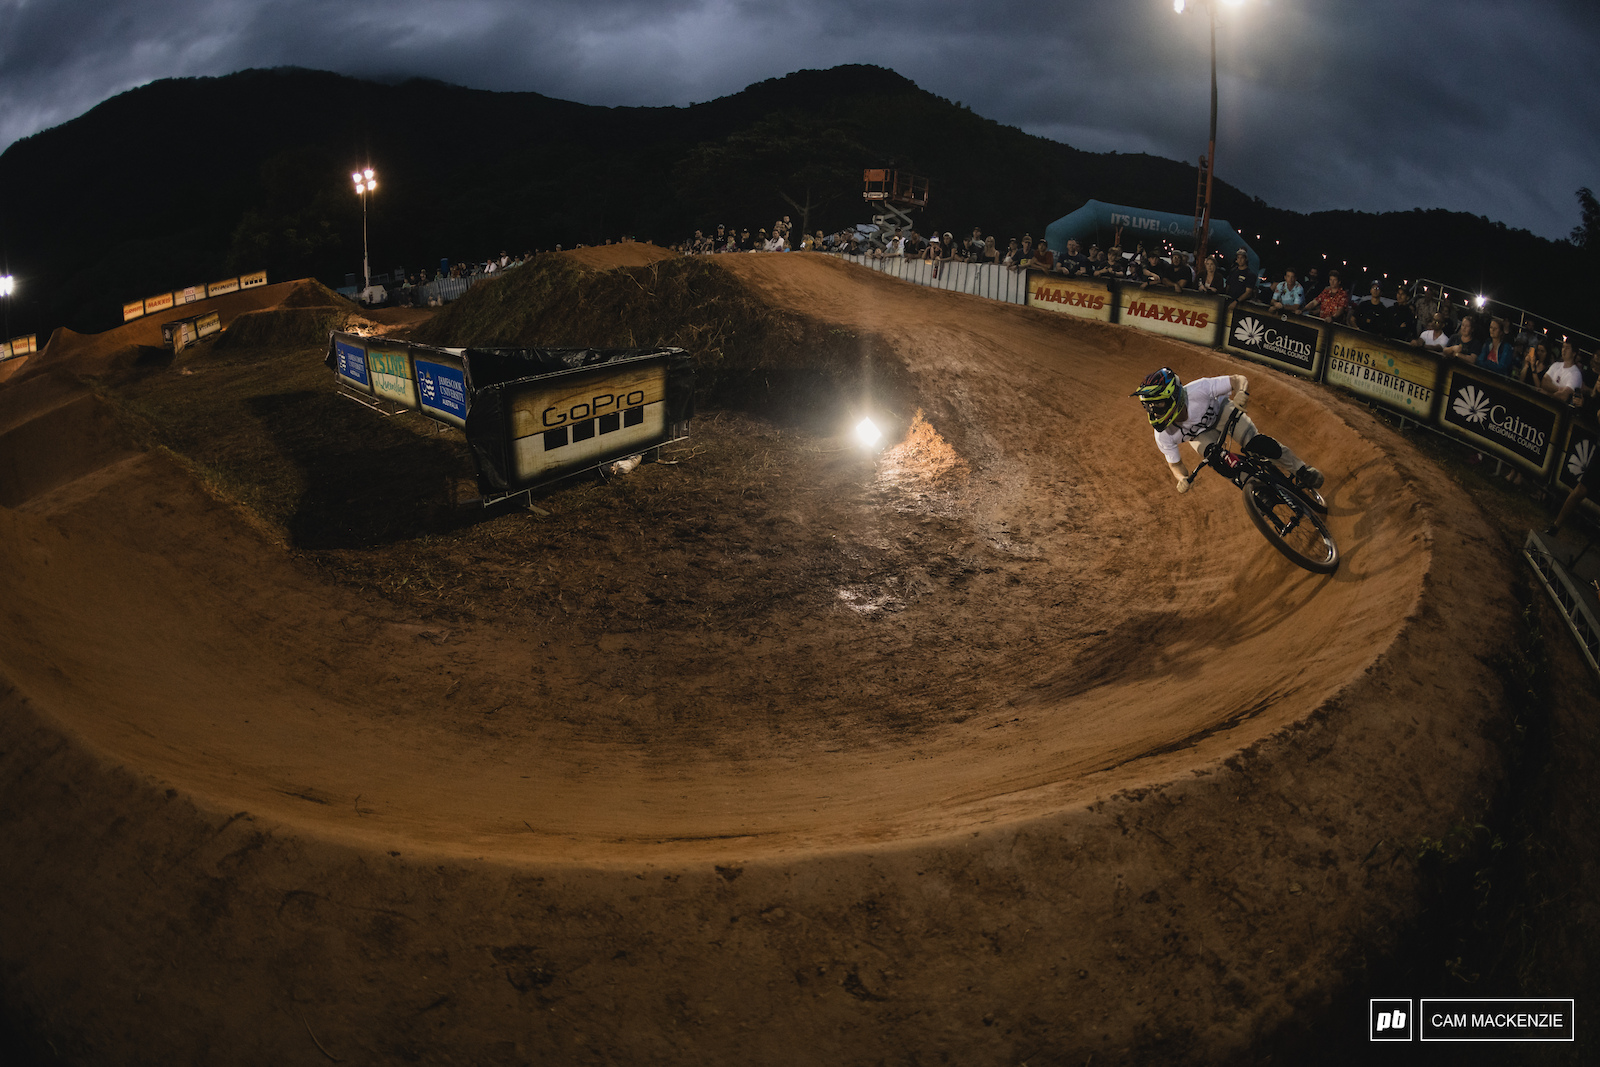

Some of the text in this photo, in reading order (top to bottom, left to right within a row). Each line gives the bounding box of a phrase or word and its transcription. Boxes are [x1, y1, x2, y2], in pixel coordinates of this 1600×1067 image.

[1111, 212, 1131, 227] IT'S
[1132, 216, 1160, 231] LIVE!
[1034, 287, 1105, 311] MAXXIS
[1127, 301, 1209, 329] MAXXIS
[1263, 327, 1312, 357] Cairns
[1263, 342, 1310, 362] REGIONAL COUNCIL
[1333, 344, 1376, 367] CAIRNS &
[1331, 359, 1431, 402] GREAT BARRIER REEF
[542, 389, 645, 428] GoPro
[1488, 423, 1542, 455] REGIONAL COUNCIL
[1490, 404, 1546, 448] Cairns
